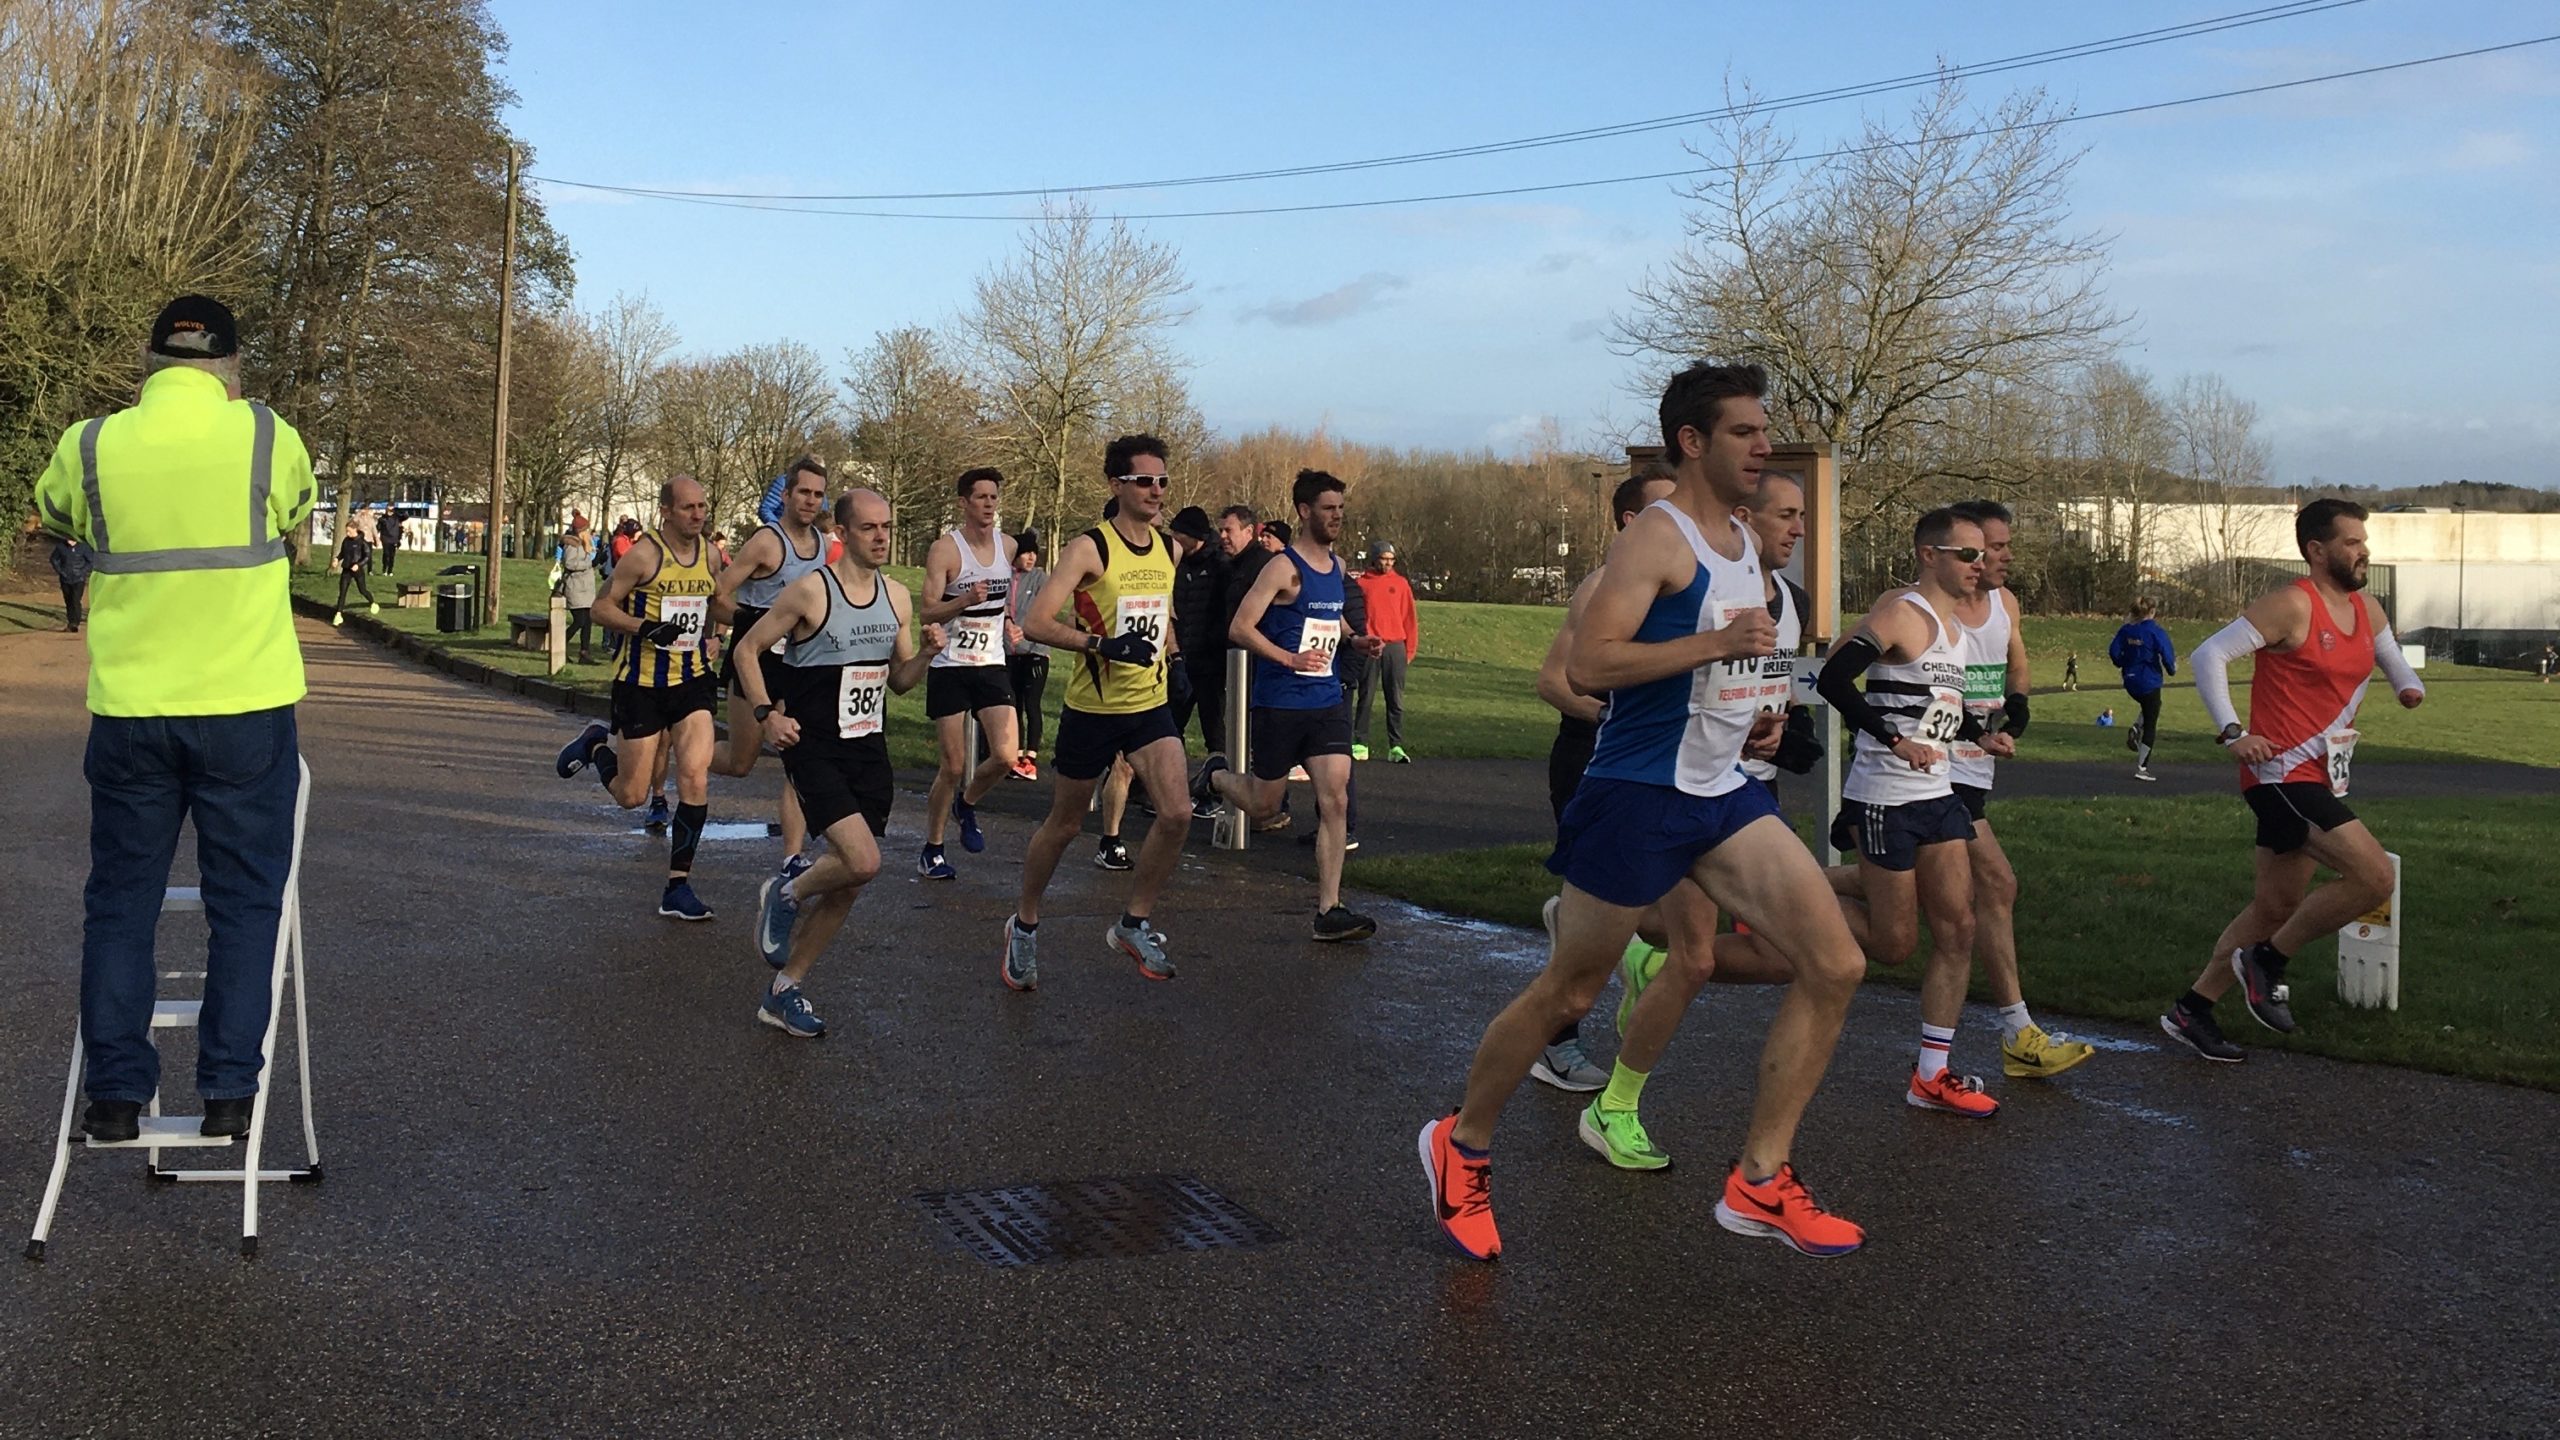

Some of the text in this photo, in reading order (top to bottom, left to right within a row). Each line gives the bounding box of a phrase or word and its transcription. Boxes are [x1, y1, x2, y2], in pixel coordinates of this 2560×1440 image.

[174, 320, 205, 331] WOLVES
[1119, 569, 1168, 582] WORCESTER
[656, 579, 711, 594] SEVERN
[1120, 582, 1168, 591] ATHLETIC CLUB
[849, 636, 885, 647] RUNNING
[957, 630, 989, 652] 279
[852, 670, 879, 681] TELFORD
[1966, 670, 2004, 681] DBURY
[1719, 687, 1747, 701] TELFORD
[1965, 684, 2002, 693] ARRIERS
[847, 685, 883, 716] 387
